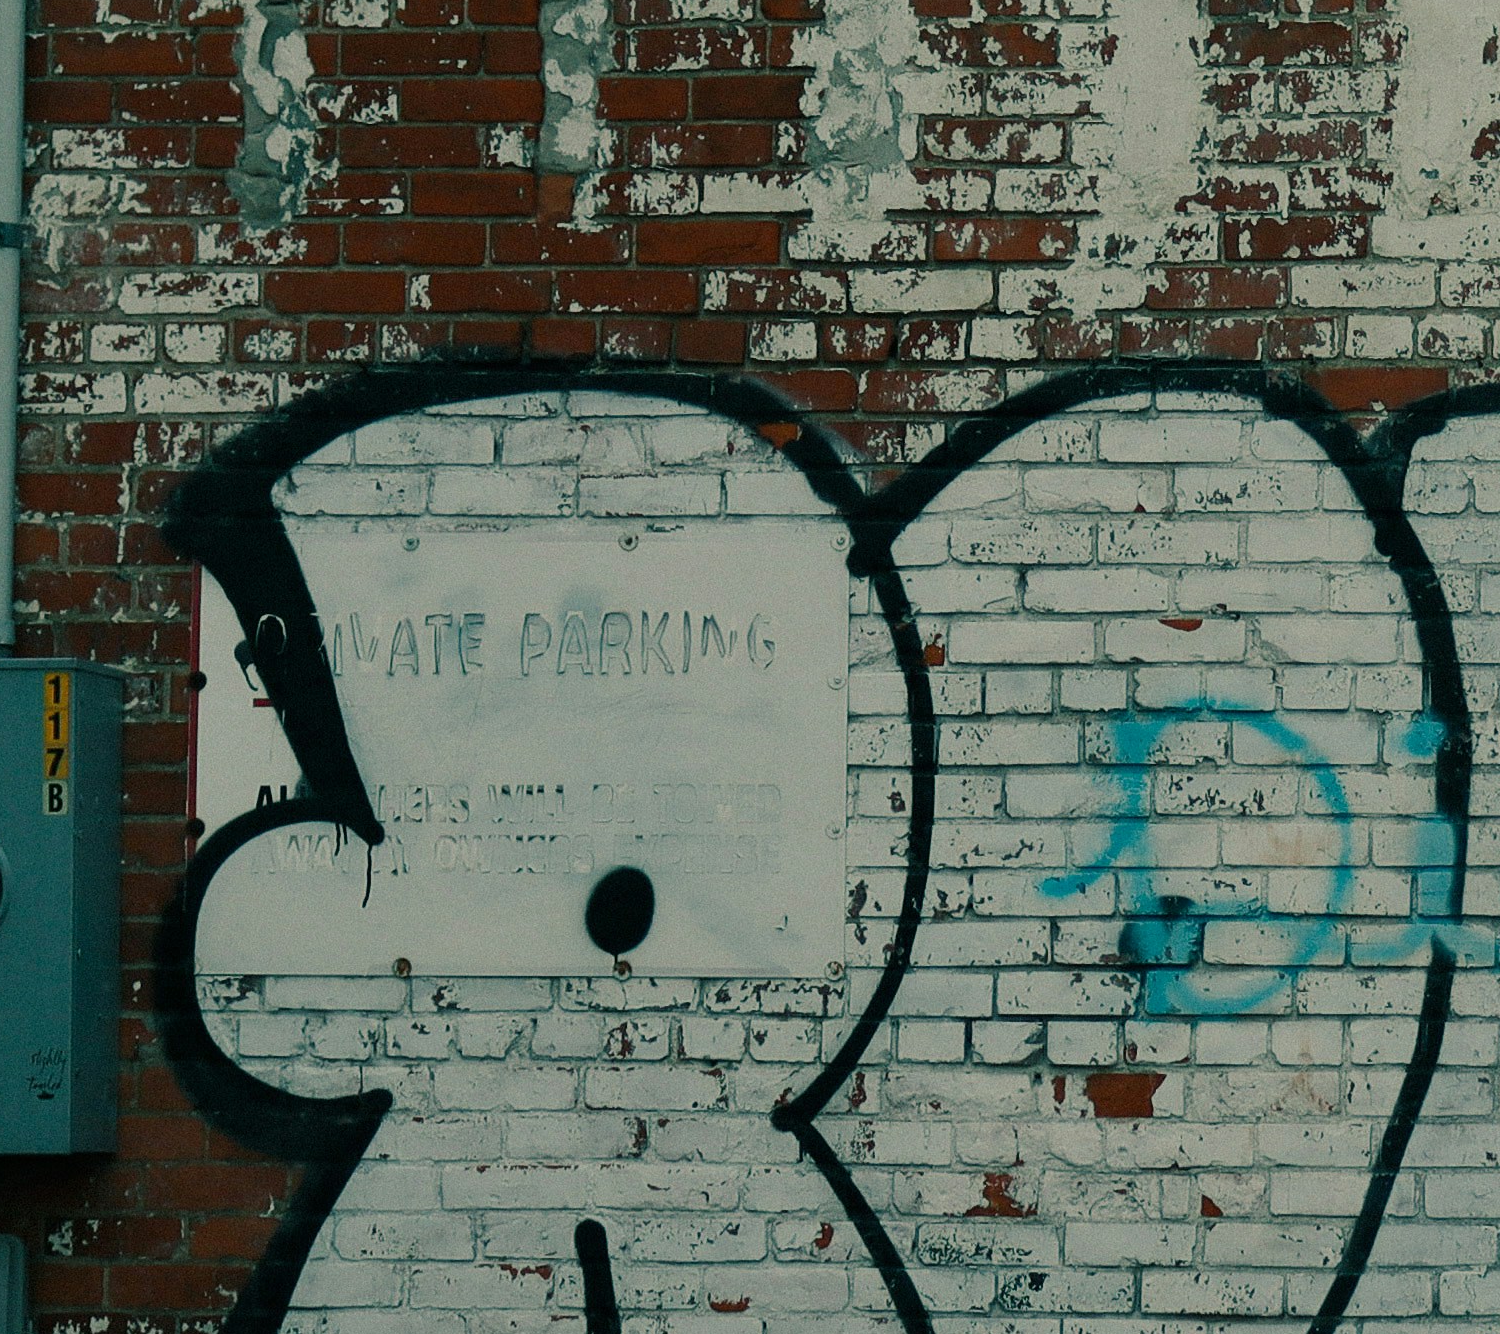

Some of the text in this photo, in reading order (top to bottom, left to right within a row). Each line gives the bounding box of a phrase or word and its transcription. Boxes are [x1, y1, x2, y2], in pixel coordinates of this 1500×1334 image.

[255, 610, 778, 676] PIVATE PARKING
[368, 783, 470, 824] HERS
